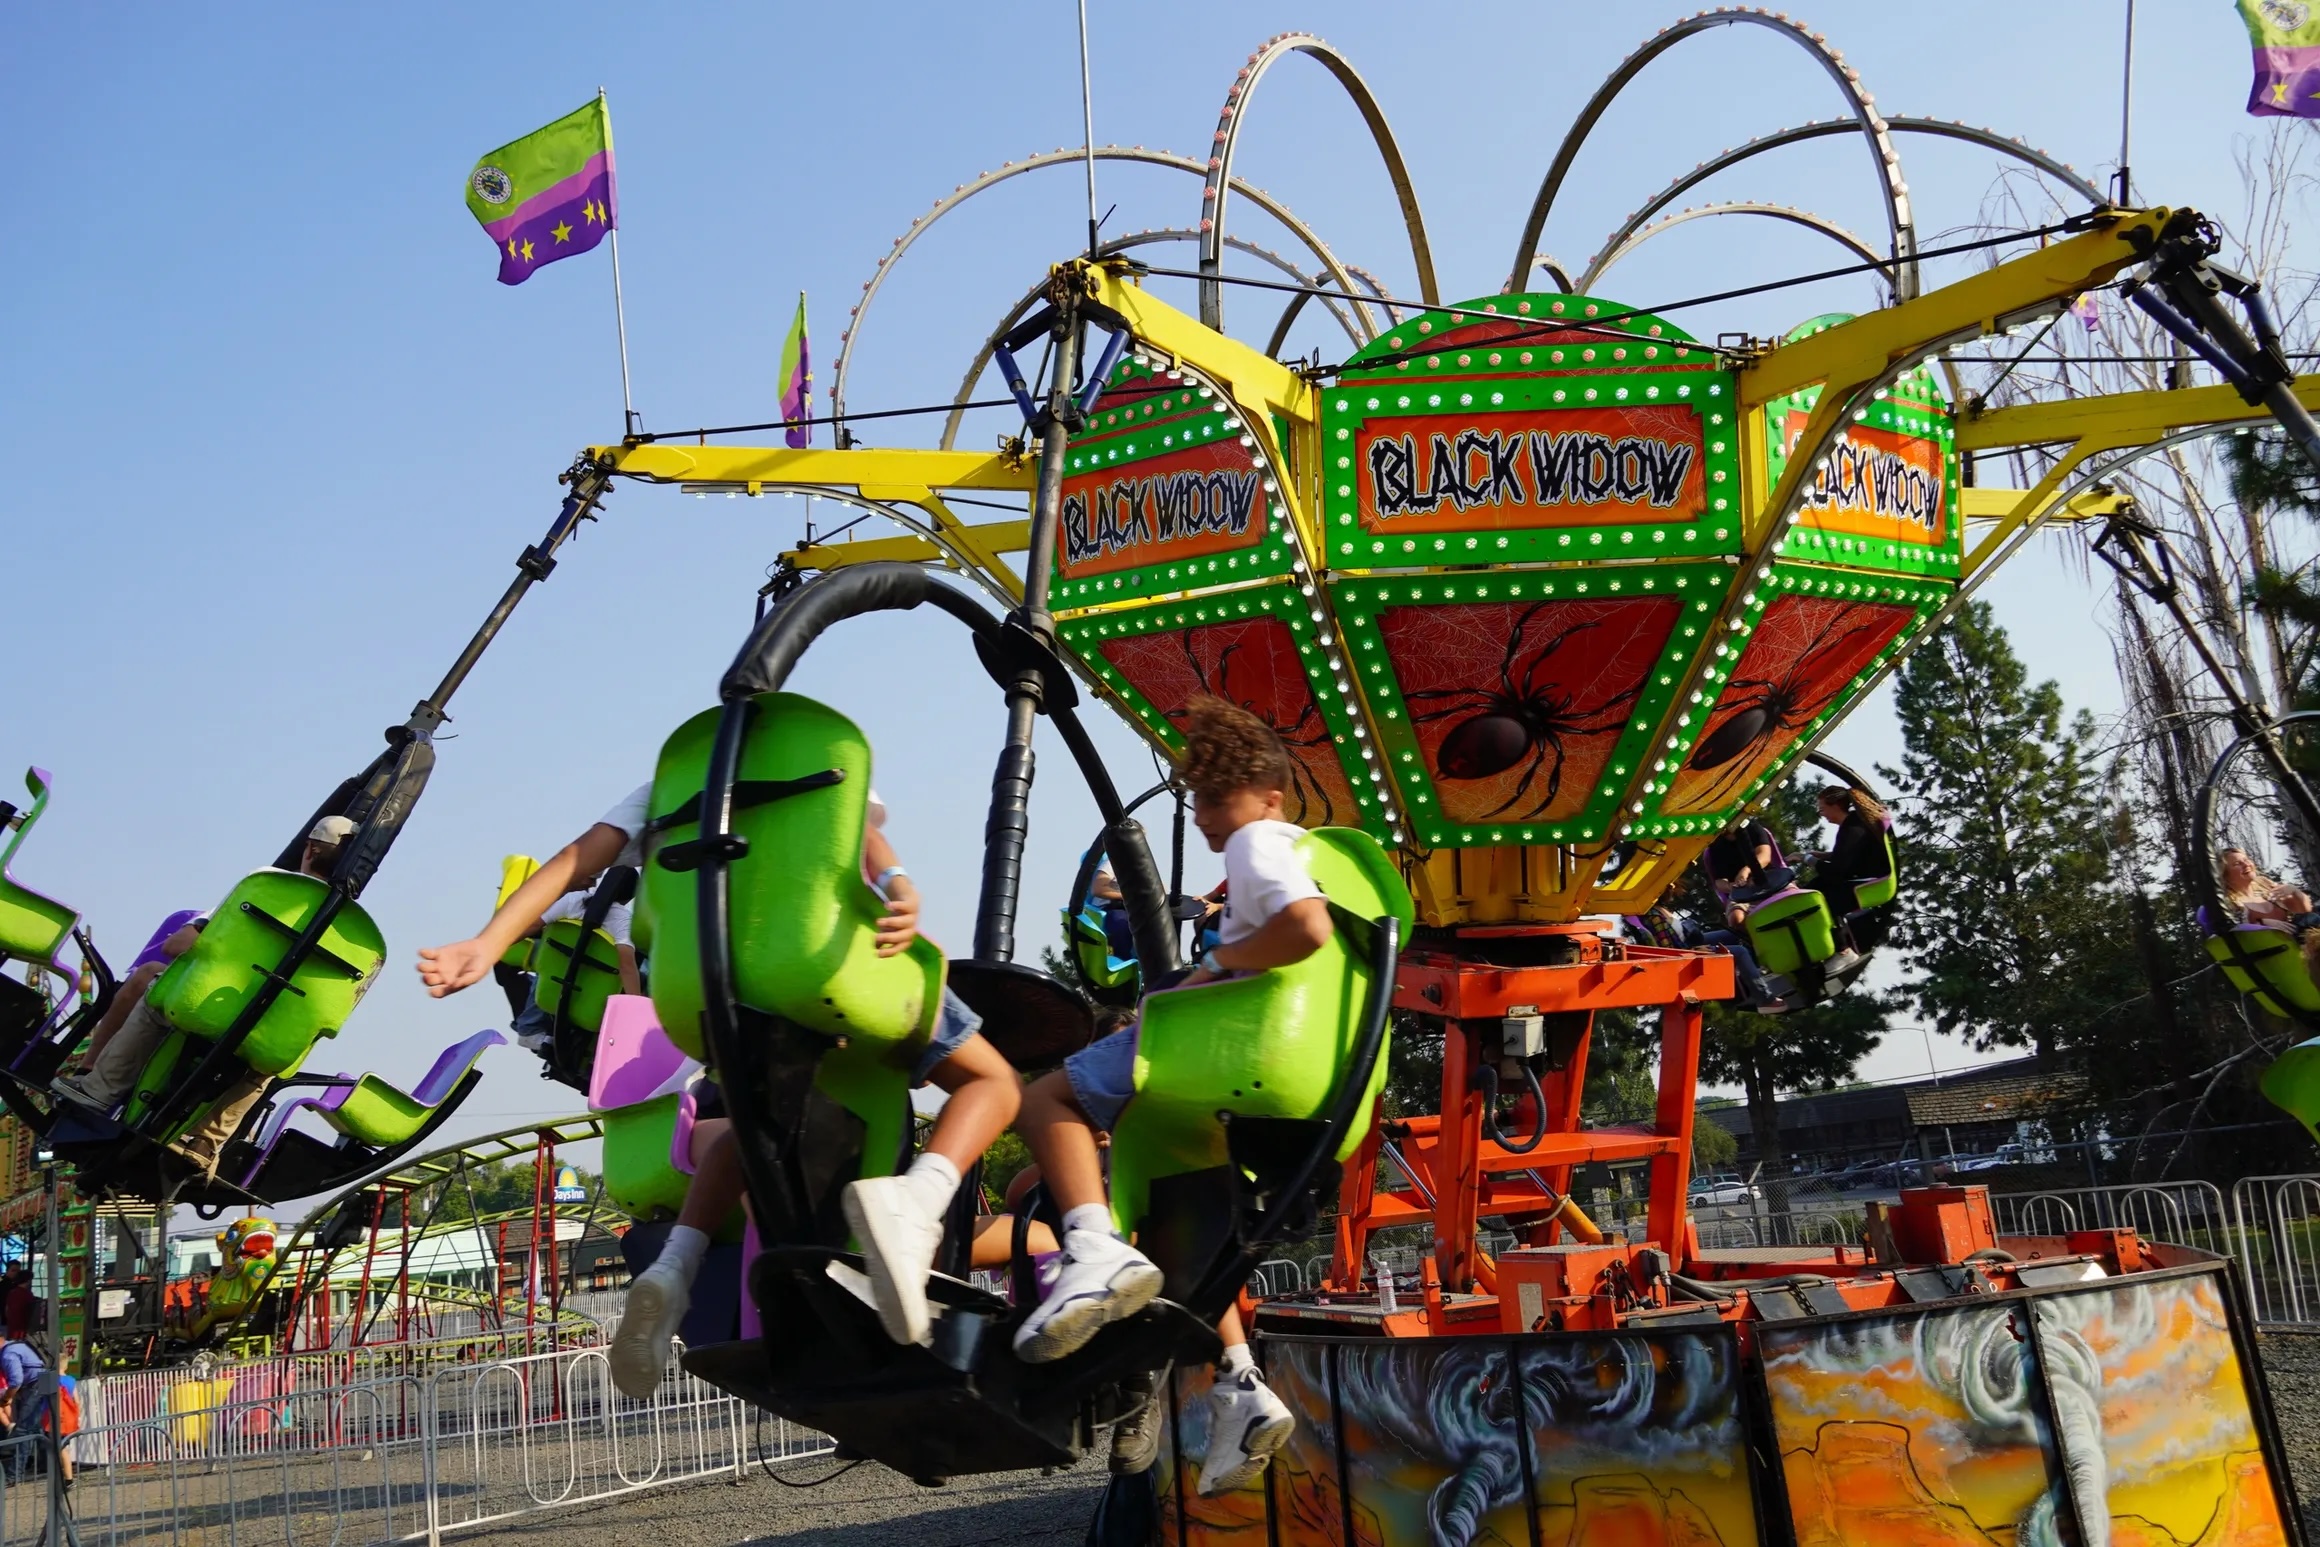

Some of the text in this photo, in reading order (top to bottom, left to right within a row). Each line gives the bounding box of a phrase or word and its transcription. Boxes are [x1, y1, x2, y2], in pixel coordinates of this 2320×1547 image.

[1368, 429, 1695, 519] BLACK WIDOW
[1871, 446, 1941, 531] WIDOW
[1063, 471, 1258, 565] BLACK WIDOW
[572, 1189, 585, 1199] Inn
